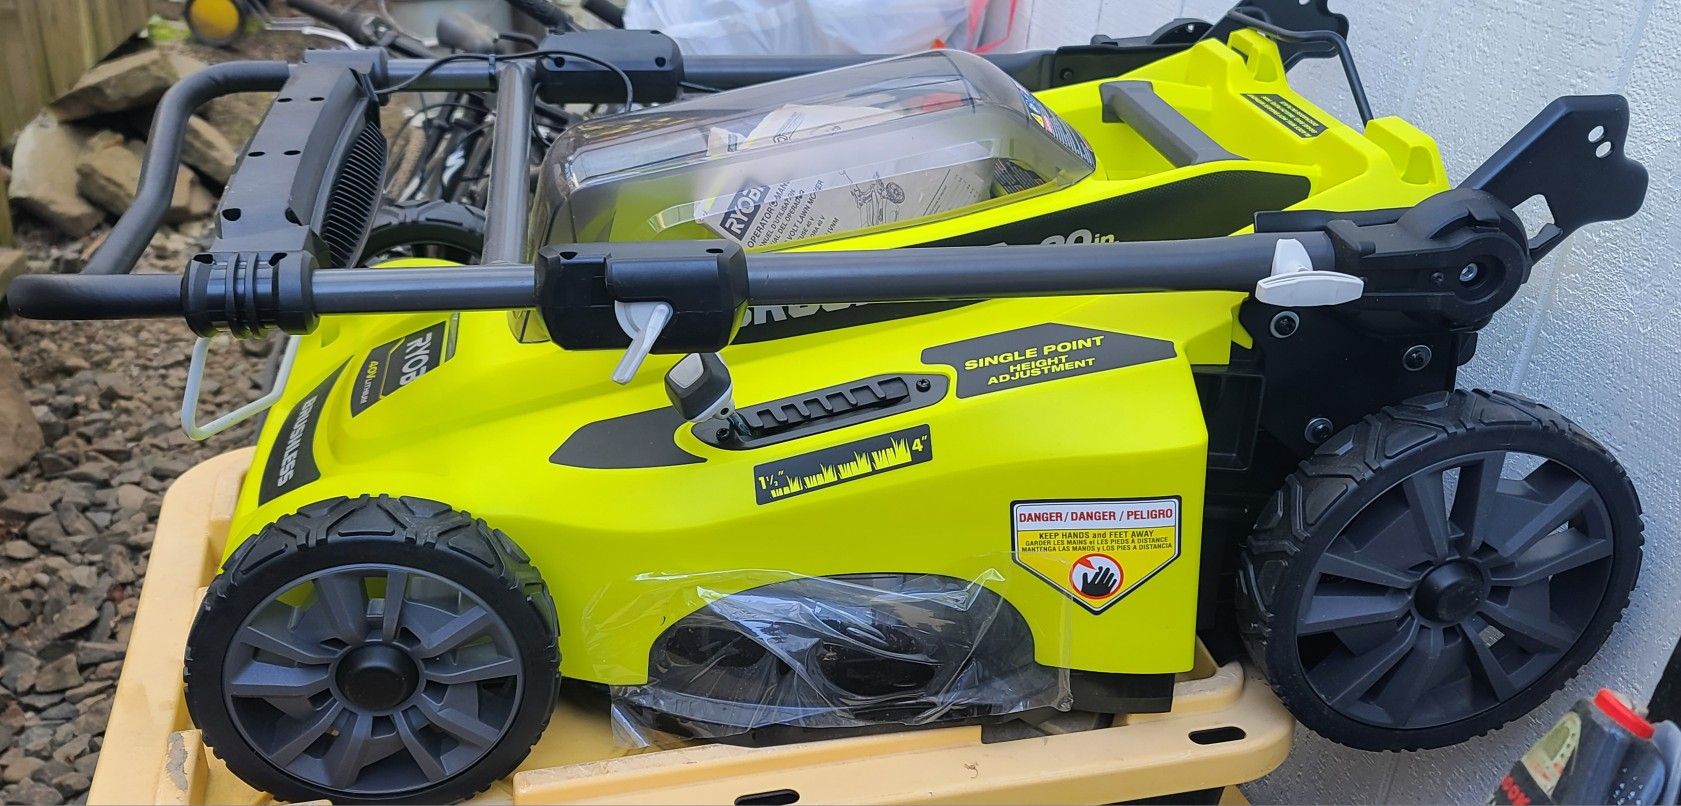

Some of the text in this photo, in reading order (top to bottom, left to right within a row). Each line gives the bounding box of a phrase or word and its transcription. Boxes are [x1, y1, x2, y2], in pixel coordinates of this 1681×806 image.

[786, 222, 800, 241] VOLT
[798, 203, 812, 225] LAWN
[964, 335, 1105, 371] SINGLE POINT
[986, 357, 1096, 386] ADJUSTMENT
[1009, 354, 1069, 373] HEIGHT
[277, 395, 318, 487] BRUSHLESS
[1019, 511, 1063, 523] DANGER
[1070, 511, 1116, 522] DANGER
[1126, 508, 1173, 521] PELIGRO
[1025, 539, 1052, 547] GARDER
[1066, 538, 1087, 546] MAINS
[1110, 537, 1130, 545] PIEDS
[1137, 536, 1169, 544] DISTANCE
[1039, 529, 1155, 540] KEEP HANDS and FEET AWAY
[1021, 545, 1057, 553] MANTENGA
[1139, 542, 1173, 550] DISTANCIA
